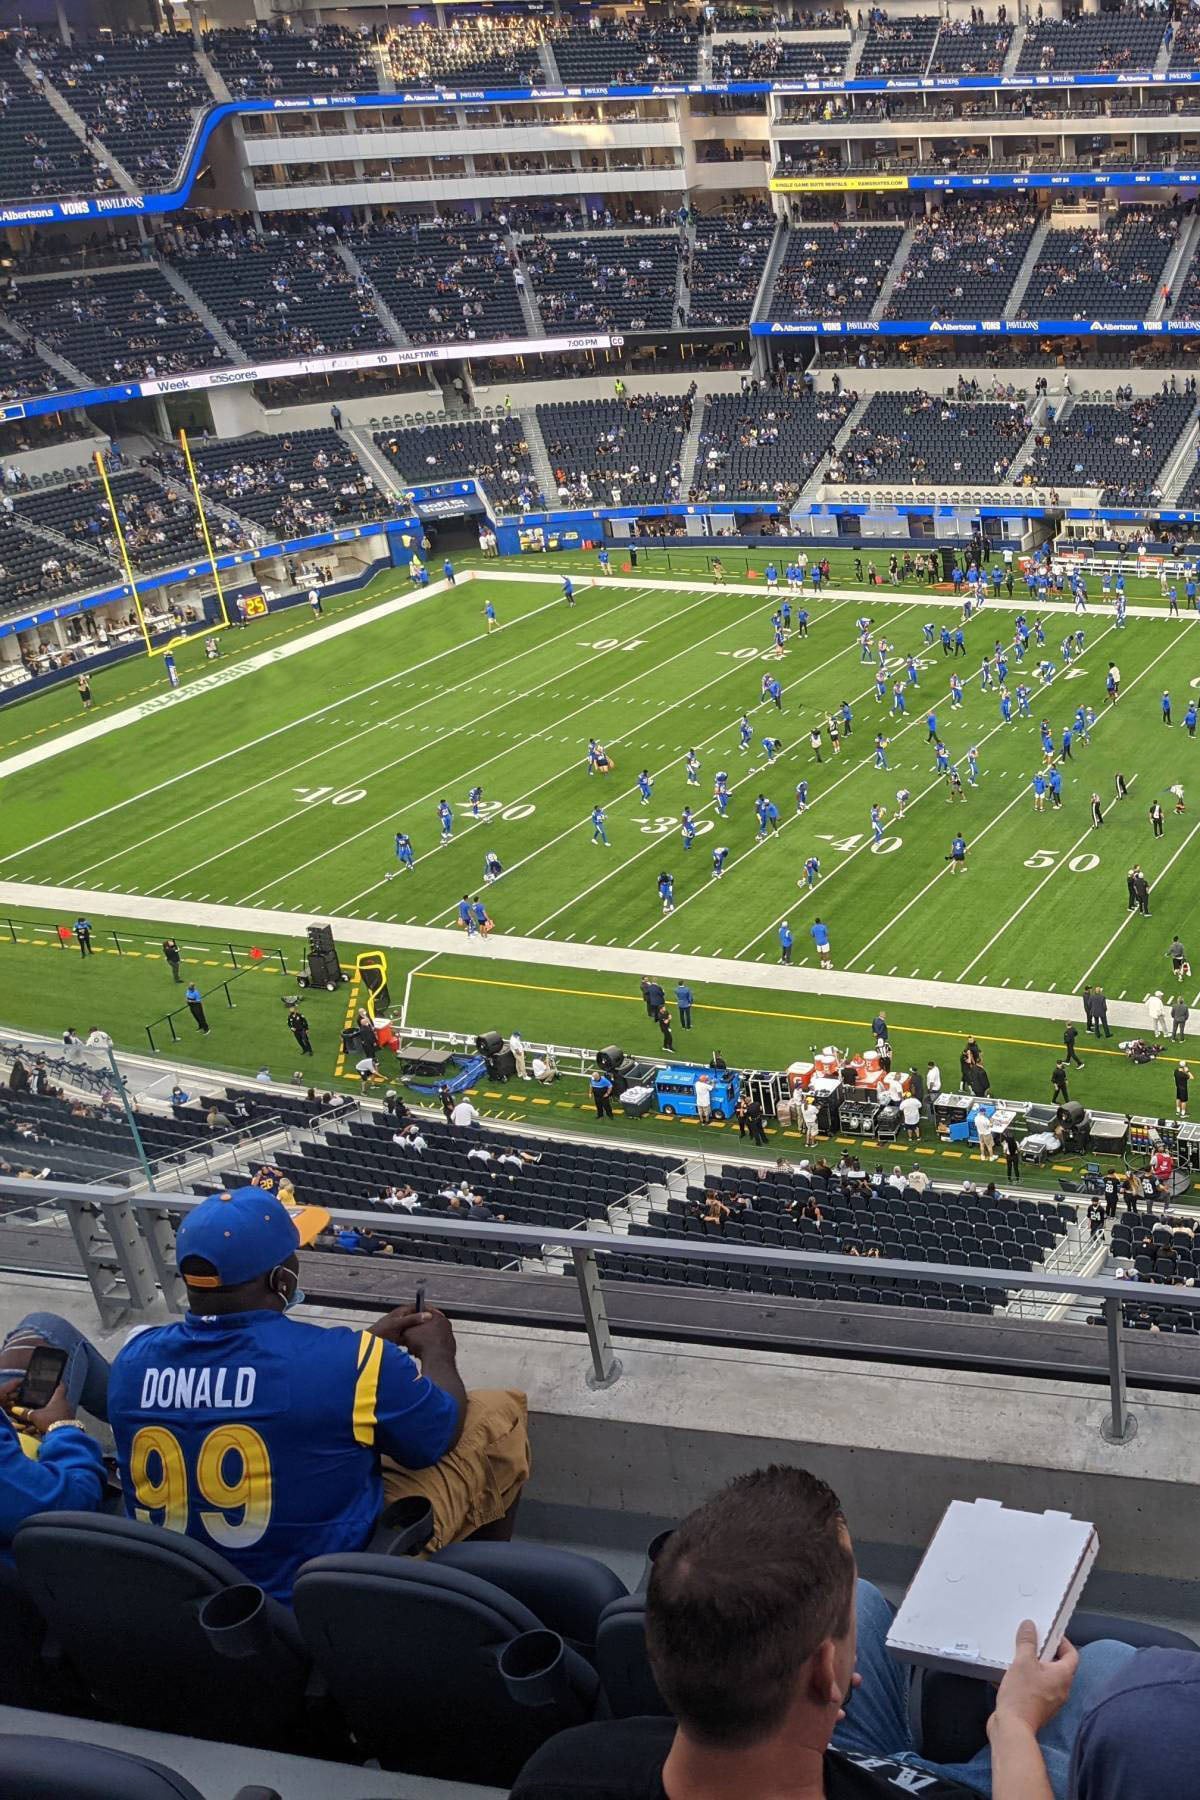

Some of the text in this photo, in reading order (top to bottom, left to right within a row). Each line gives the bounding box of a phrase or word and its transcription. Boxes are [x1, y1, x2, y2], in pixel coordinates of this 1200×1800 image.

[2, 197, 144, 221] Albertsons VONS PAVILIONS
[783, 324, 817, 332] Albertsons
[822, 323, 842, 331] VONS
[981, 322, 1001, 330] VONS
[1101, 323, 1138, 331] Albertsons
[1143, 322, 1162, 330] VONS
[567, 339, 585, 348] 7:00
[377, 351, 439, 364] 10 HALFTIME
[157, 380, 190, 392] Week
[247, 597, 265, 615] 25
[294, 787, 367, 805] 10
[460, 801, 536, 820] 20
[640, 817, 715, 837] 30
[830, 834, 903, 854] 40
[1023, 849, 1100, 872] 50
[140, 1366, 257, 1410] DONALD
[130, 1423, 272, 1549] 99
